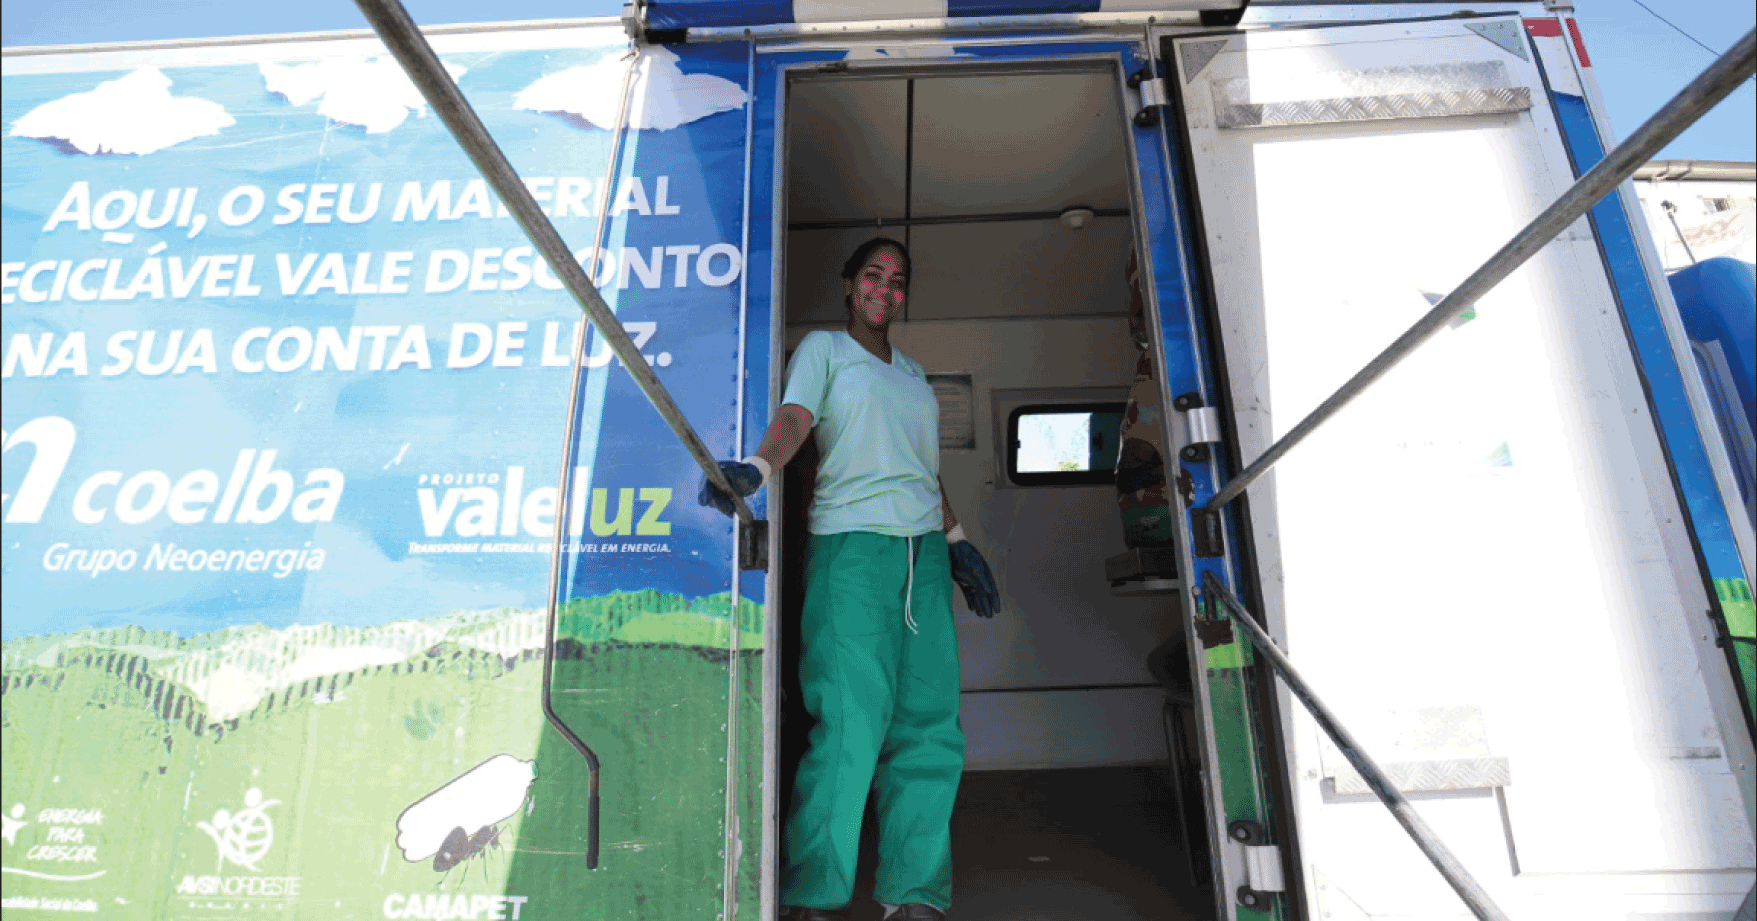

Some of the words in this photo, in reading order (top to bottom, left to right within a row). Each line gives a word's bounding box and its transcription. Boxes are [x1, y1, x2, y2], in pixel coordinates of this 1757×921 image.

[42, 181, 207, 244] AQUI,
[218, 185, 265, 226] O
[272, 183, 382, 225] SEU
[276, 252, 413, 295] VALE
[2, 331, 87, 378] NA
[102, 329, 217, 375] SUA
[231, 325, 432, 374] CONTA
[447, 322, 527, 369] DE
[72, 448, 345, 523] coelba
[418, 473, 500, 485] PROJETO
[43, 542, 137, 579] Grupo
[143, 541, 326, 579] Neoenergia
[600, 543, 618, 553] EM
[621, 543, 672, 553] ENERGIA.
[383, 893, 528, 921] CAMAPET
